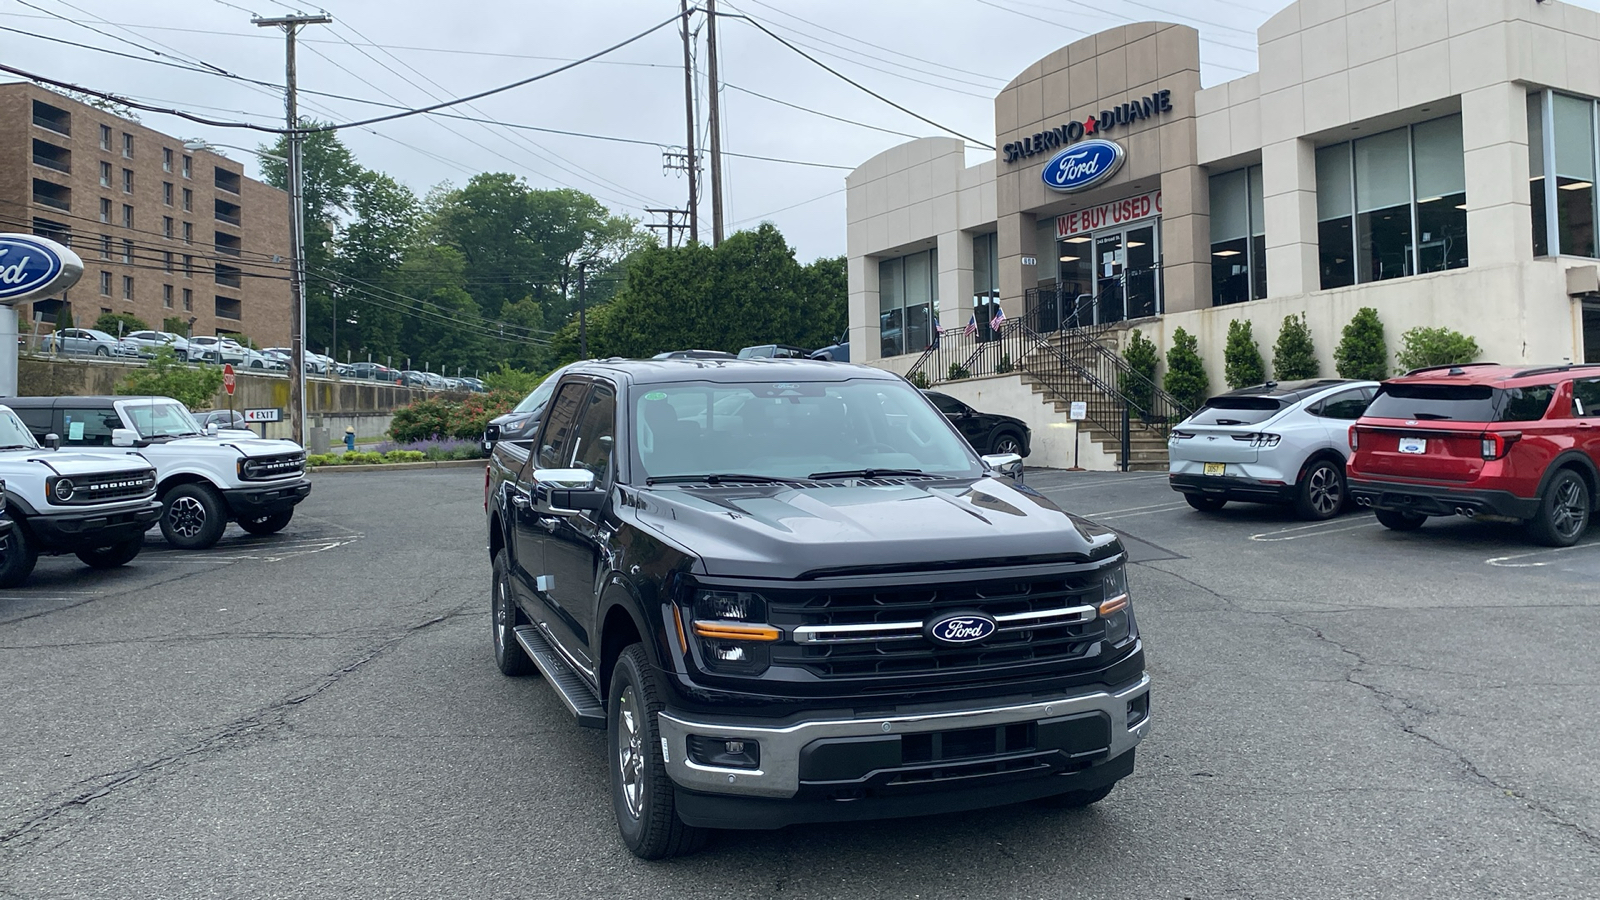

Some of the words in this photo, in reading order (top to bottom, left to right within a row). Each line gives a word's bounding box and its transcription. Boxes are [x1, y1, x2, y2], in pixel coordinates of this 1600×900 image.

[1003, 120, 1083, 163] SALERNO
[1100, 89, 1173, 131] DUANE
[1056, 151, 1099, 184] Ford
[1057, 213, 1078, 236] WE
[1081, 205, 1108, 230] BUY
[1112, 195, 1150, 224] USED
[256, 411, 274, 419] EXIT
[90, 480, 143, 490] BRONCO
[945, 620, 983, 638] Ford
